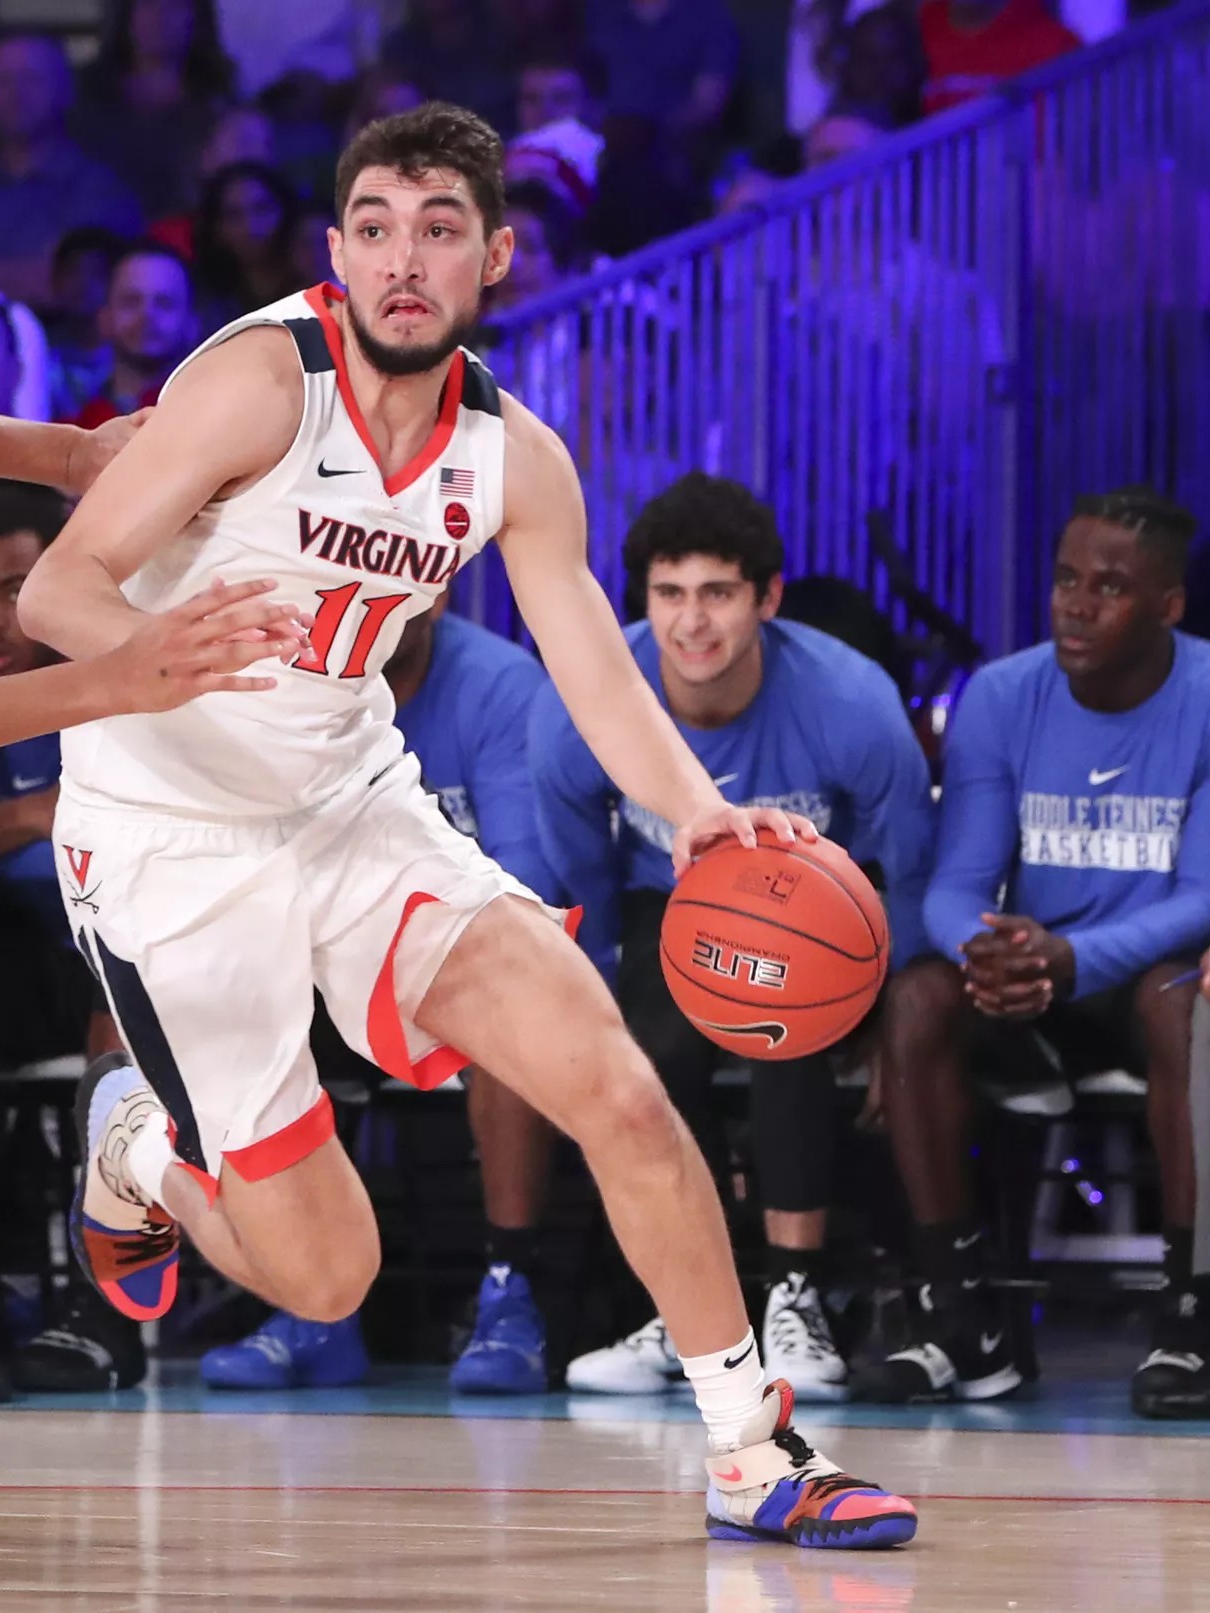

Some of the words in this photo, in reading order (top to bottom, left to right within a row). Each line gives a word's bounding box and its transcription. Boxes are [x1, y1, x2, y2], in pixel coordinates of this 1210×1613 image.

[298, 508, 460, 584] VIRGINIA
[292, 581, 412, 679] 11
[1021, 792, 1091, 830] IDDLE
[692, 938, 789, 990] ELITE
